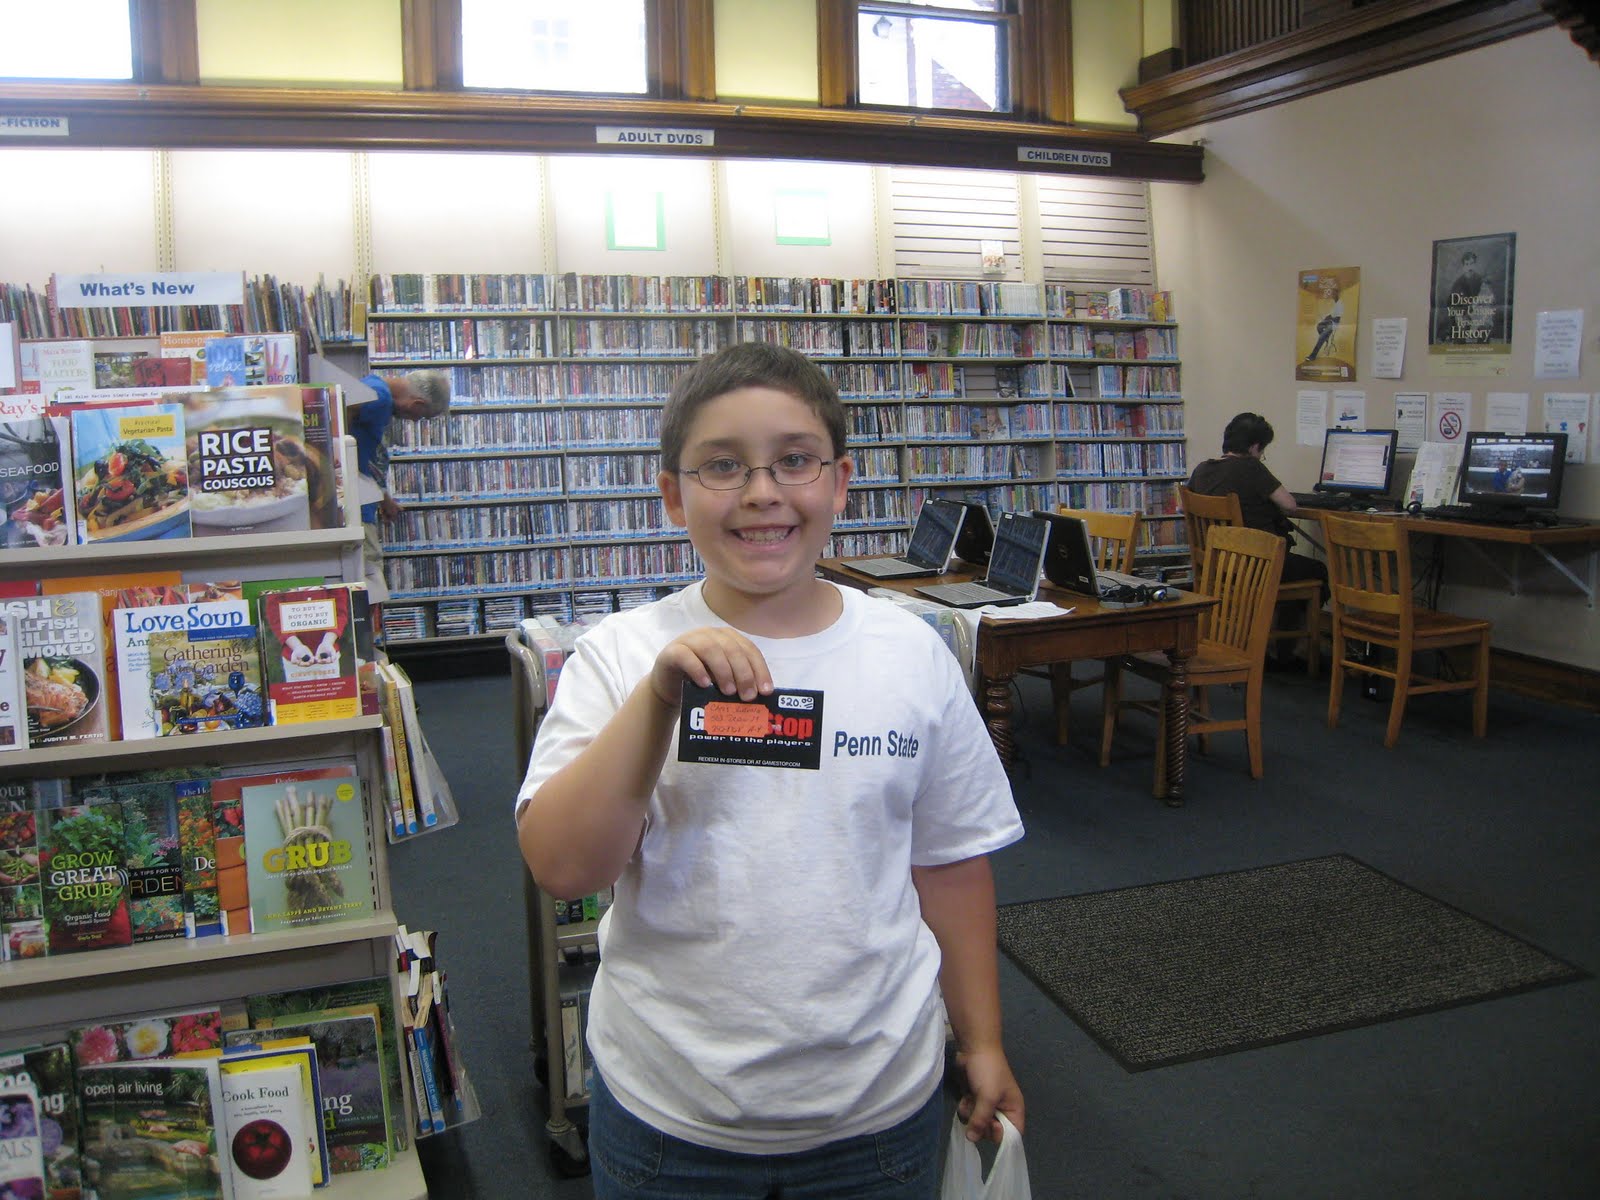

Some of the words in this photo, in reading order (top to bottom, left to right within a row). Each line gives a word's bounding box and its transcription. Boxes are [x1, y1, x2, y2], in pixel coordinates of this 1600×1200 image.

[617, 132, 662, 143] ADULT
[667, 133, 703, 145] DVDS
[1027, 150, 1079, 163] CHILDREN
[1082, 154, 1108, 165] DVDS
[80, 281, 146, 297] What's
[152, 282, 195, 296] New
[1451, 292, 1494, 306] Discover
[1447, 306, 1465, 317] Your
[1467, 305, 1496, 318] Unique
[1451, 326, 1491, 342] History
[208, 358, 243, 373] relax
[123, 427, 155, 436] Vegetarian
[201, 429, 271, 456] RICE
[0, 461, 59, 478] SEAFOOD
[203, 456, 274, 476] PASTA
[203, 476, 275, 490] COUSCOUS
[125, 611, 184, 633] Love
[187, 604, 243, 629] Soup
[290, 619, 328, 628] ORGANIC
[21, 629, 95, 647] ILLED
[163, 643, 242, 662] Gathering
[194, 658, 249, 675] Garden
[689, 734, 726, 742] power
[767, 738, 811, 747] players
[834, 731, 881, 757] Penn
[887, 730, 919, 758] State
[762, 759, 801, 767] GAMESTOP.COM
[51, 850, 114, 870] GROW
[263, 840, 352, 873] GRUB
[51, 865, 117, 886] GREAT
[140, 869, 154, 877] TIPS
[58, 882, 113, 901] GRUB
[65, 913, 93, 922] Organic
[94, 910, 111, 918] Food
[85, 1083, 115, 1097] open
[118, 1082, 132, 1094] air
[135, 1081, 163, 1096] living
[222, 1088, 255, 1102] Cook
[259, 1086, 289, 1099] Food
